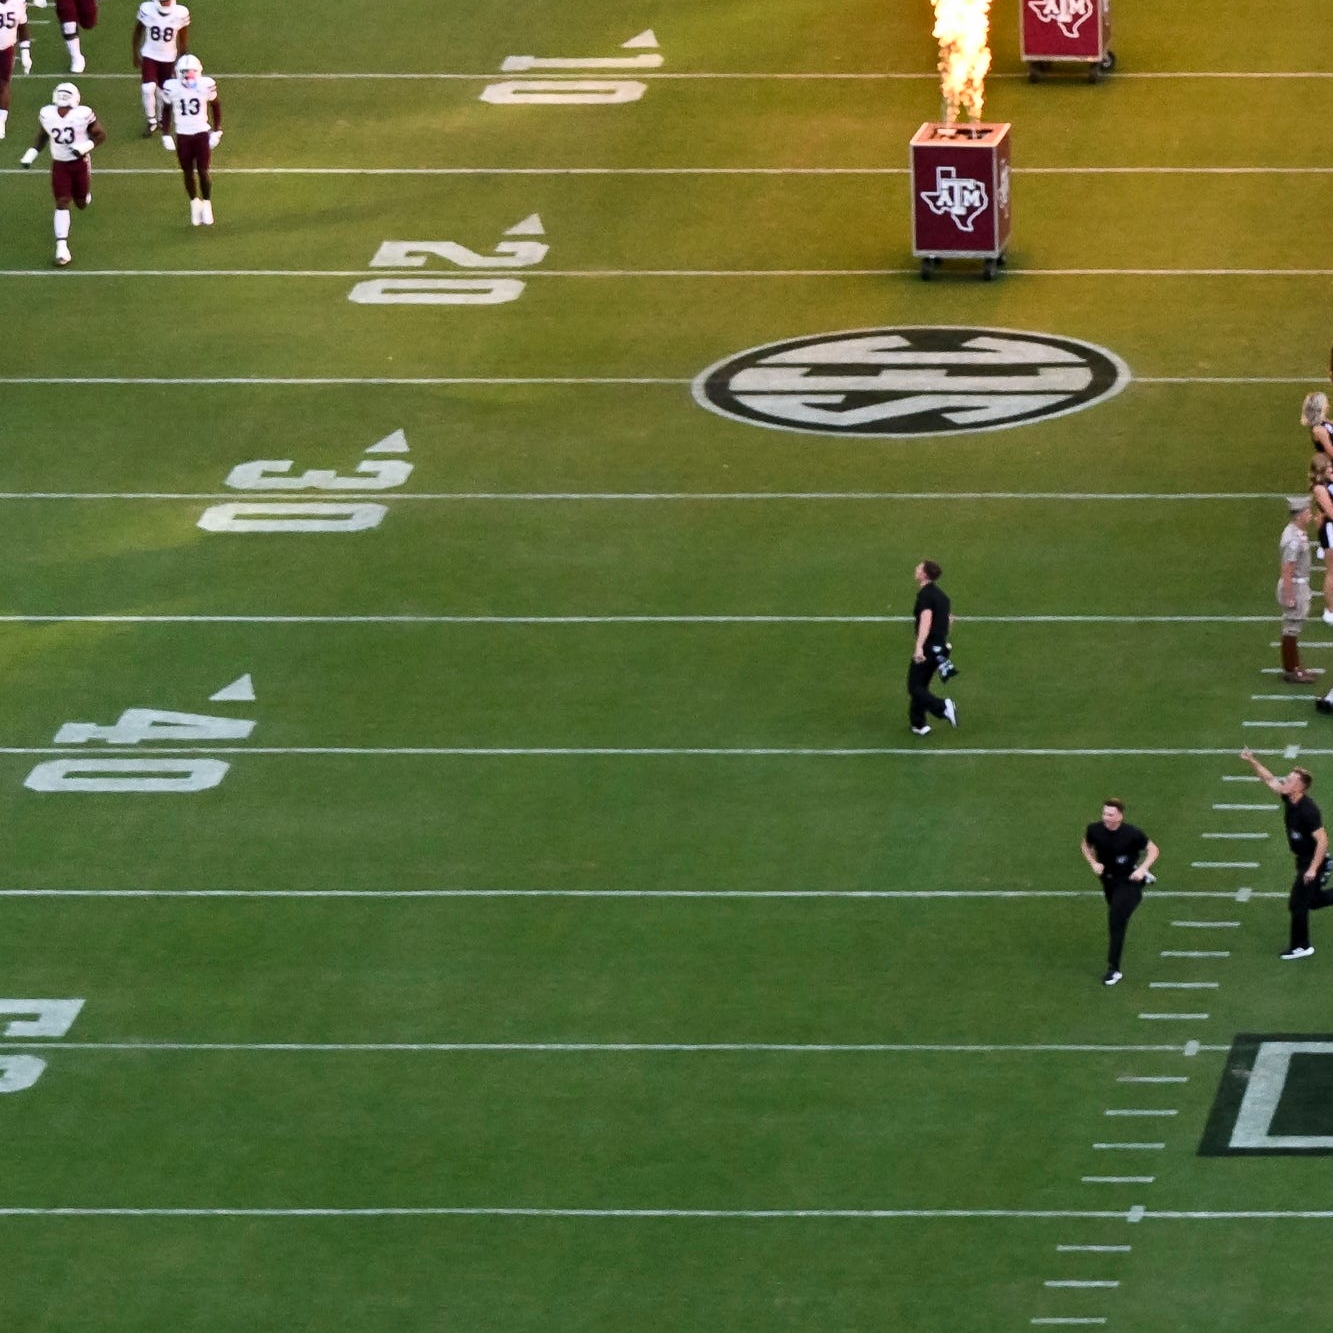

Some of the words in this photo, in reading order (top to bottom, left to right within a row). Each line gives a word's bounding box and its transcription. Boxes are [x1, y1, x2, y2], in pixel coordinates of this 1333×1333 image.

[150, 26, 174, 43] 88
[180, 98, 200, 116] 13
[51, 127, 75, 145] 23
